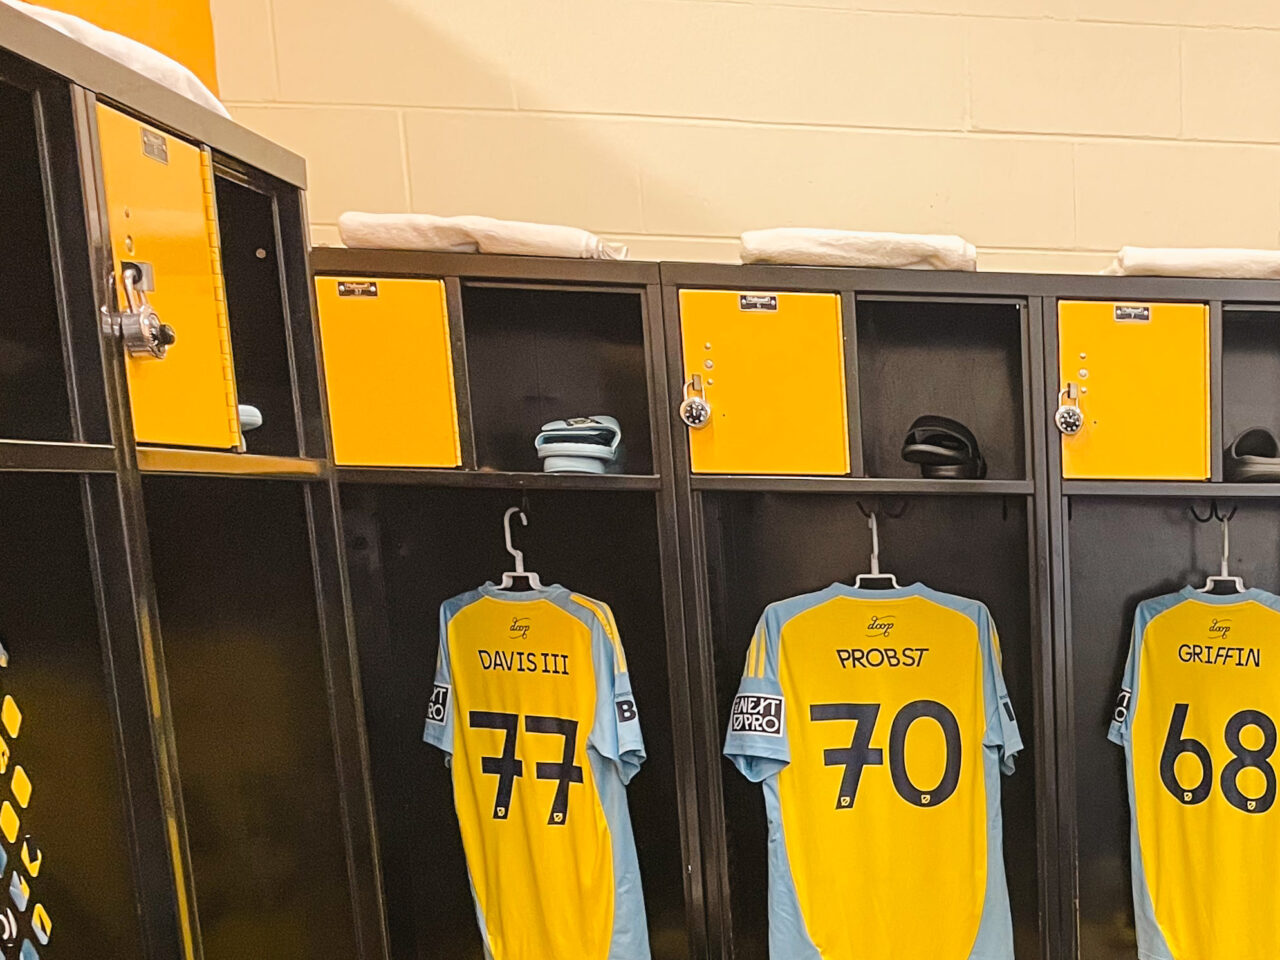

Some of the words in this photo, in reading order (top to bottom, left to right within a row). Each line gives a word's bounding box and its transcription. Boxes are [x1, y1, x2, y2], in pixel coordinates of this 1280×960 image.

[867, 615, 895, 637] doop
[477, 648, 539, 673] DAVIS
[540, 651, 569, 676] III
[836, 647, 930, 669] PROBST
[1178, 643, 1261, 668] GRIFFIN
[738, 696, 781, 715] NEXT
[809, 699, 962, 810] 70
[1159, 703, 1278, 814] 68
[468, 710, 584, 826] 77
